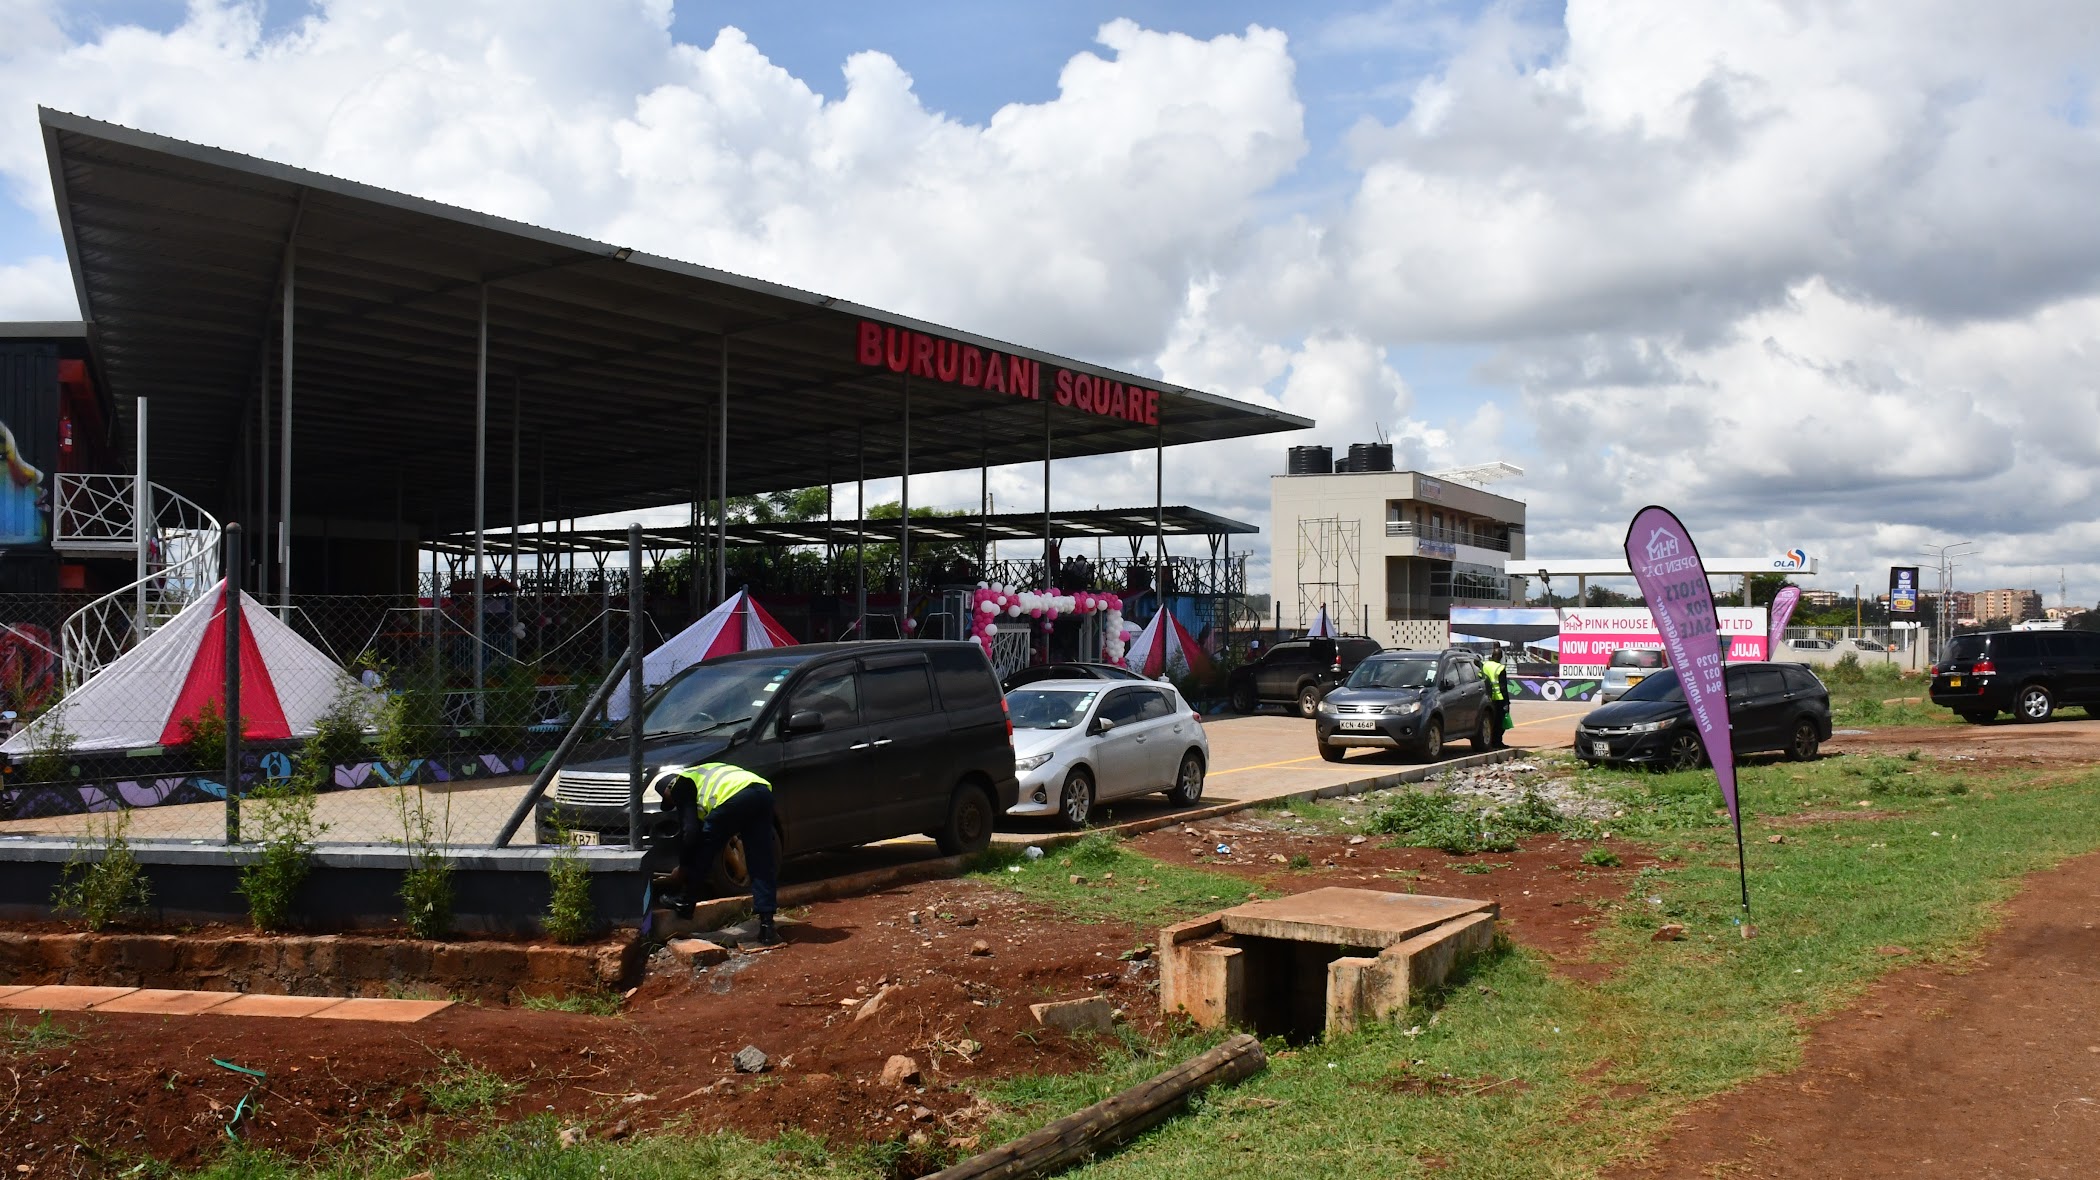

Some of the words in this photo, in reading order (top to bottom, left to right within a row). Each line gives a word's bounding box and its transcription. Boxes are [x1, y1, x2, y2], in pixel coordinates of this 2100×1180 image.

[858, 320, 1040, 400] BURUDANI
[1055, 368, 1160, 426] SQUARE
[1773, 560, 1795, 568] OLA
[1564, 620, 1583, 630] PHM
[1585, 619, 1609, 629] PINK
[1615, 618, 1648, 629] HOUSE
[1733, 619, 1753, 630] LTD
[1562, 641, 1588, 654] NOW
[1731, 643, 1760, 657] JUJA
[1563, 666, 1584, 676] BOOK
[1586, 666, 1606, 676] NOW
